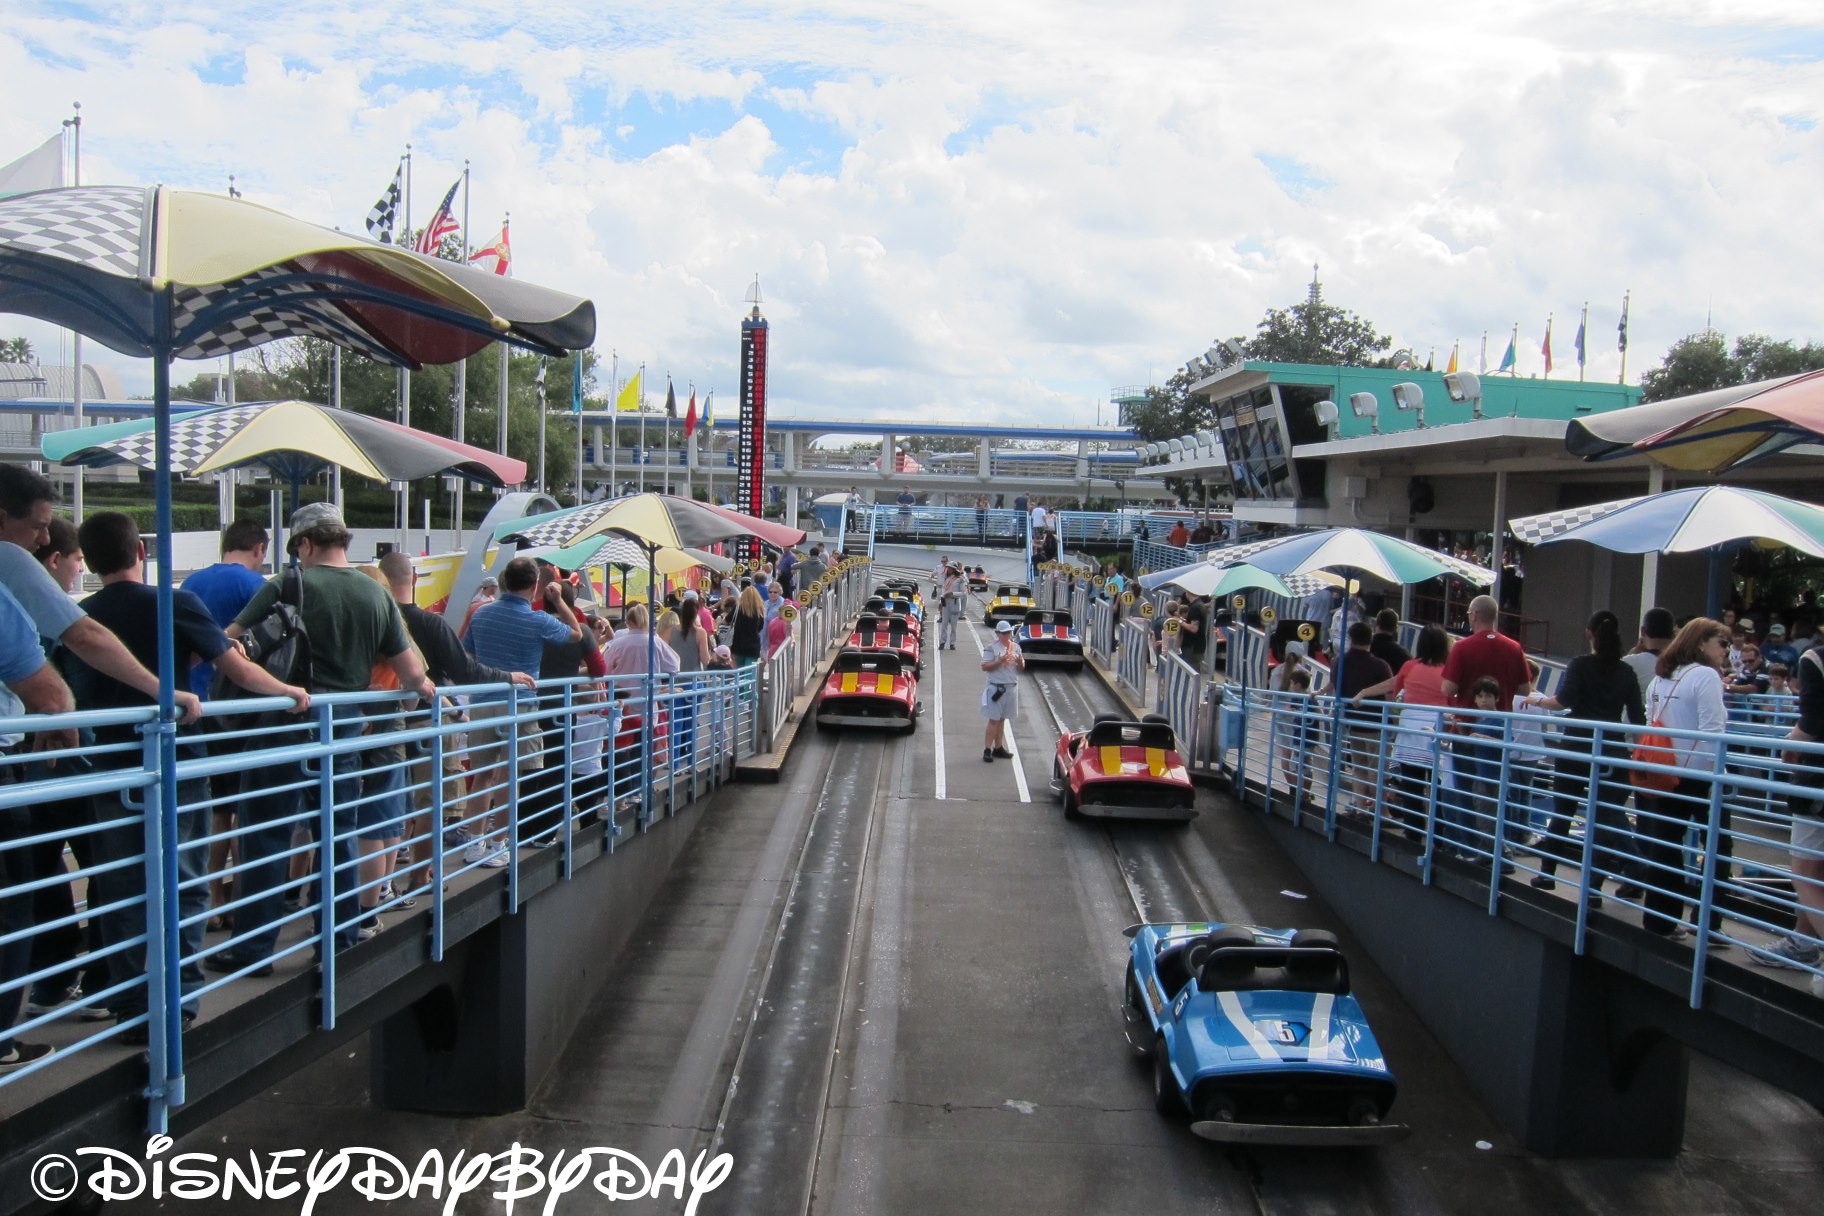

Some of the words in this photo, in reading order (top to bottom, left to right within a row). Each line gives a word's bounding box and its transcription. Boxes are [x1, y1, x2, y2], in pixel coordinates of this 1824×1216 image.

[700, 580, 708, 588] 11
[800, 594, 808, 602] 6
[784, 610, 793, 618] 6
[1143, 606, 1153, 614] 12
[1264, 610, 1273, 618] 4
[1167, 623, 1178, 632] 12
[1302, 628, 1311, 636] 4
[1274, 1021, 1295, 1042] 5
